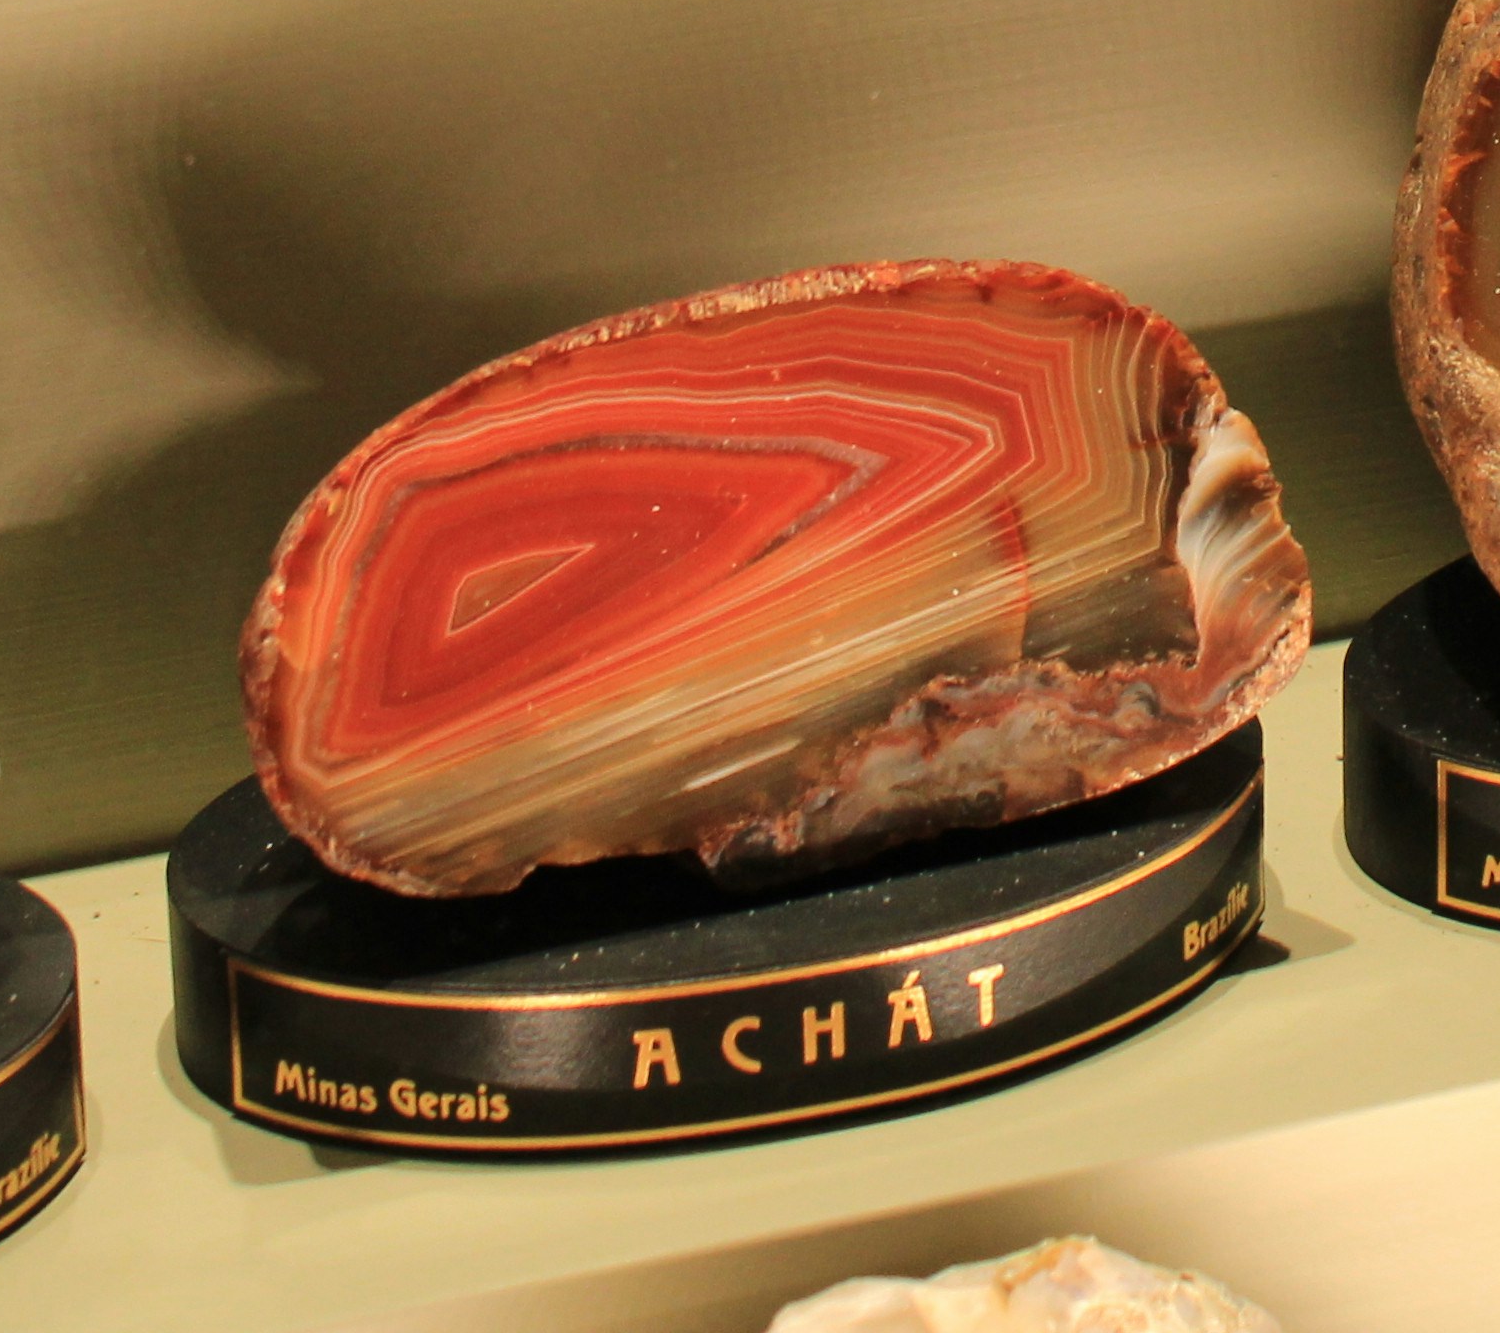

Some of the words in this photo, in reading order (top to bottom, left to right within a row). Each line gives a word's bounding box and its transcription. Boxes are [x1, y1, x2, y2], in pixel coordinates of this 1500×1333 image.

[633, 961, 1003, 1088] ACHÁT
[275, 1060, 378, 1113] Minas
[390, 1080, 510, 1121] Gerais
